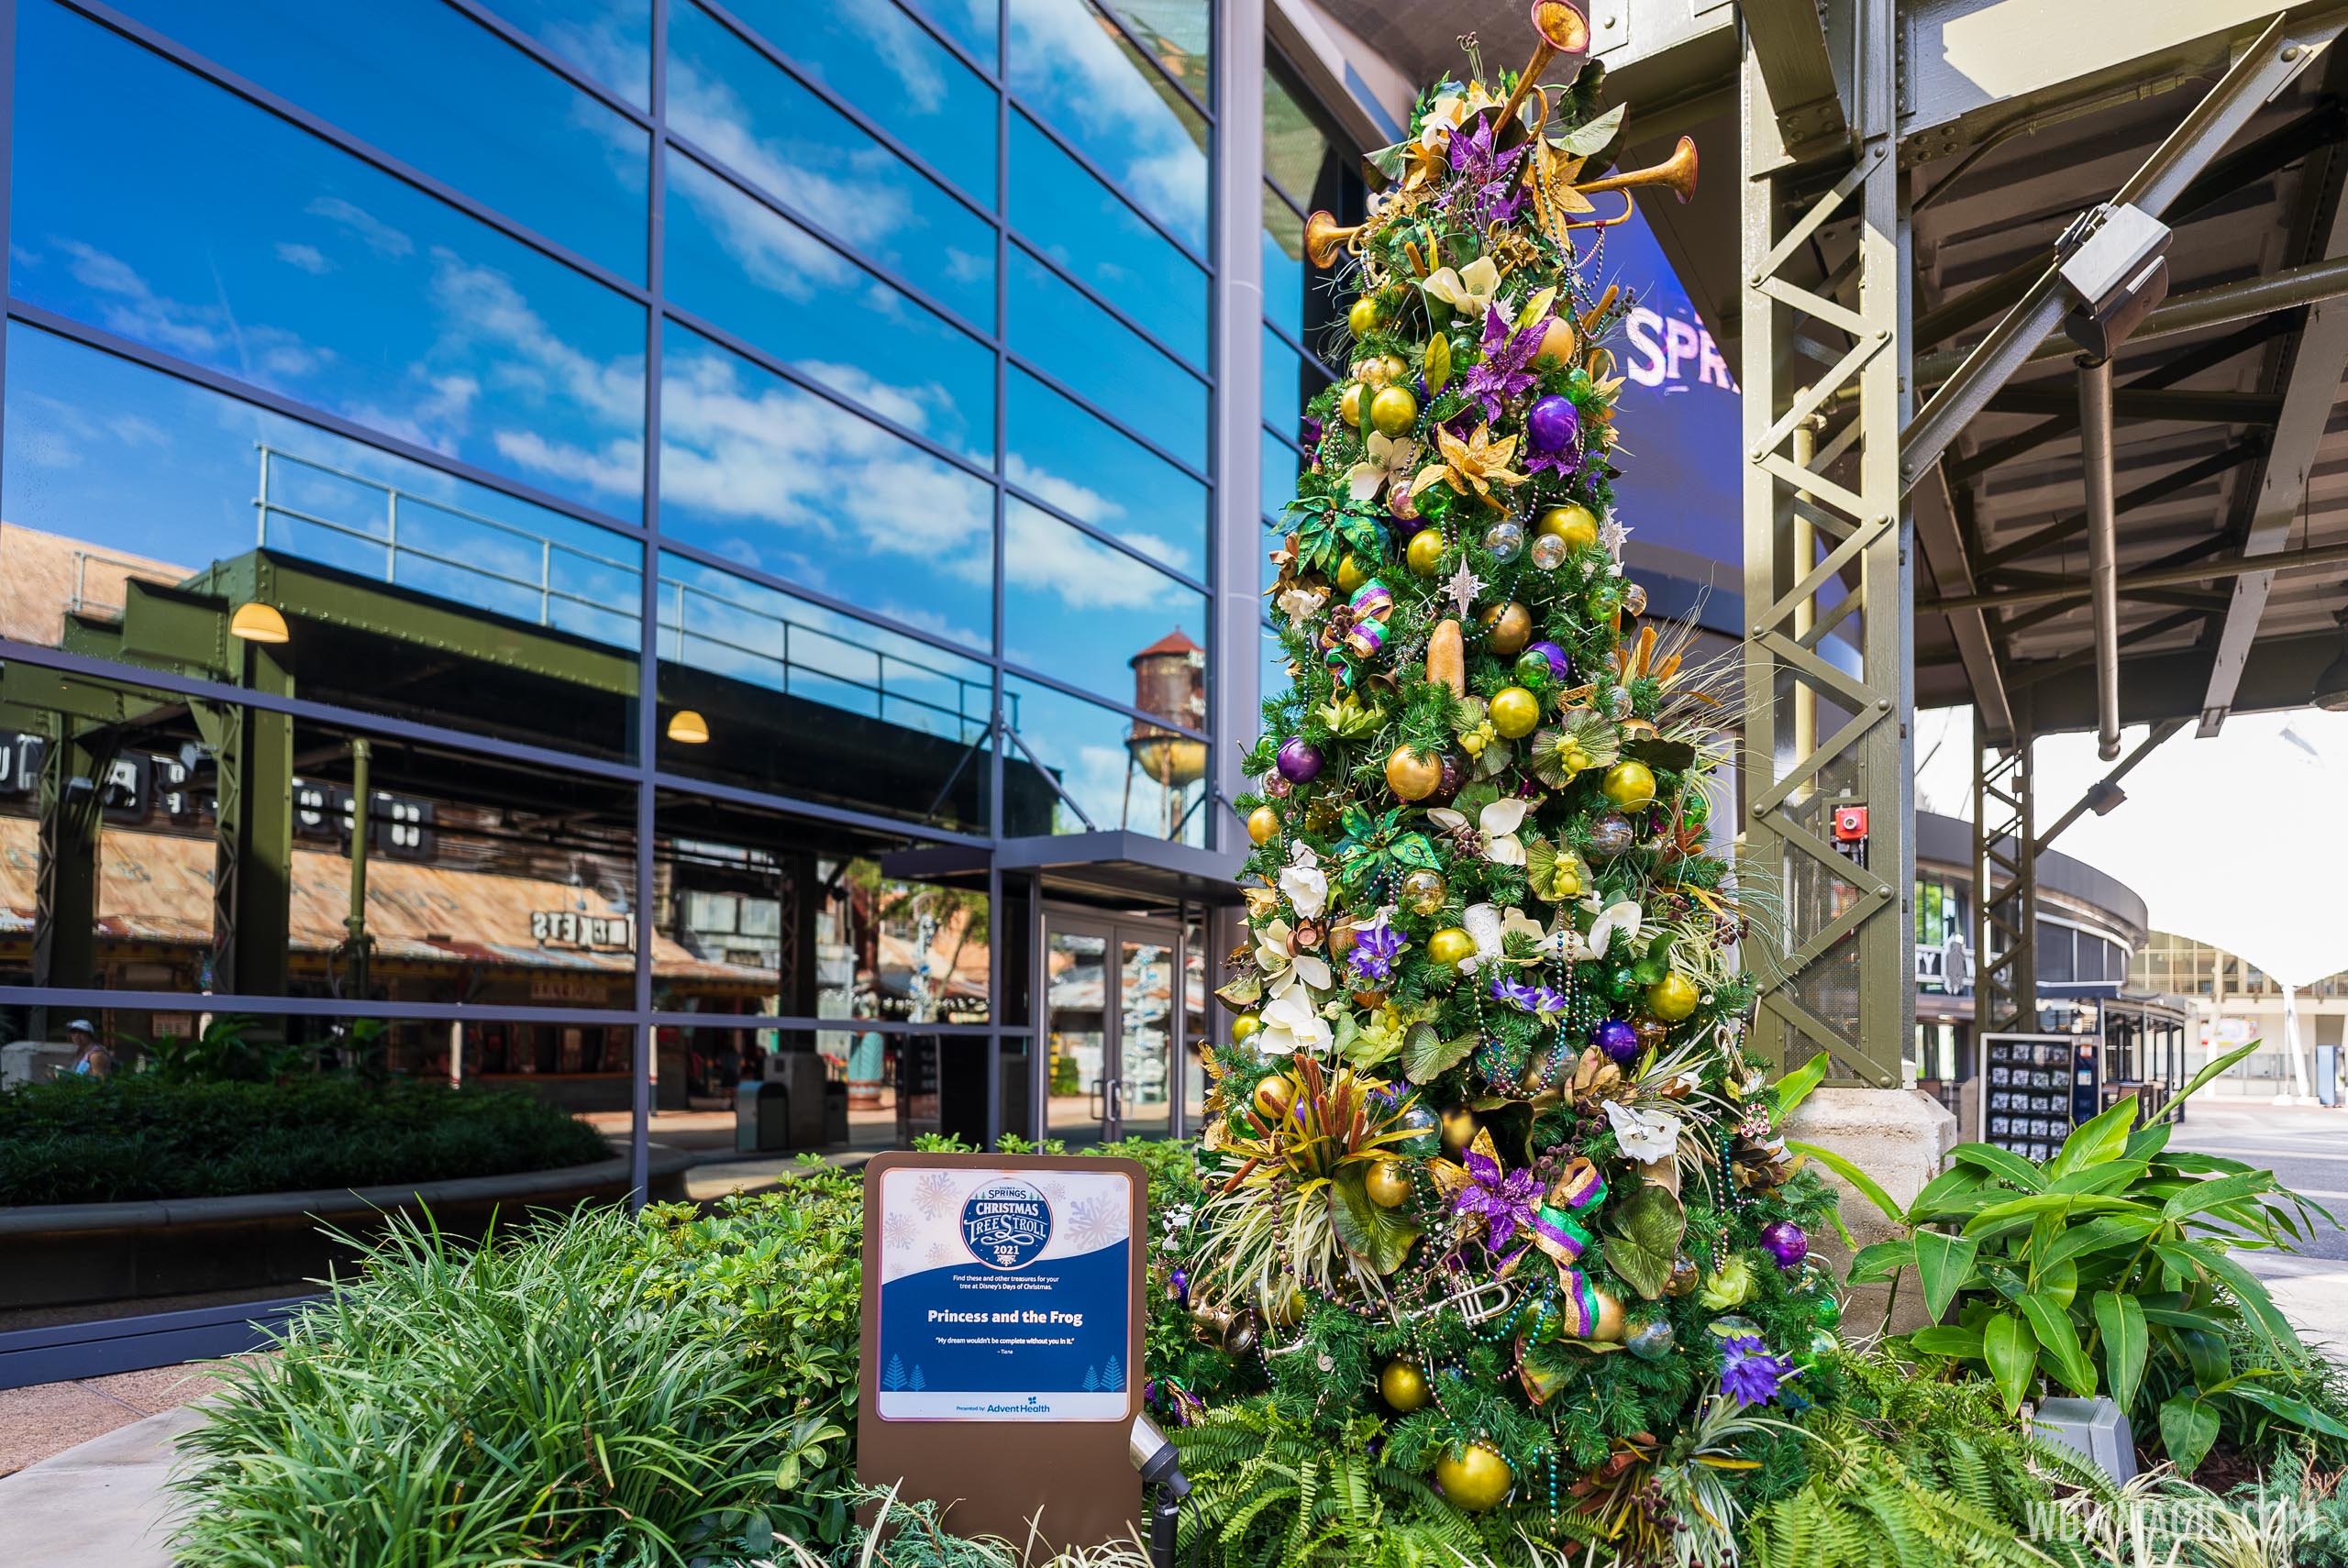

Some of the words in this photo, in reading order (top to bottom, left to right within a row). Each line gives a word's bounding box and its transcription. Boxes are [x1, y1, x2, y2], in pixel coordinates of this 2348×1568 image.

[1626, 306, 1741, 394] SPR
[988, 1189, 1026, 1199] SPRINGS
[975, 1202, 1039, 1217] CHRISTMAS
[963, 1216, 1000, 1245] TREE
[1000, 1214, 1047, 1239] STROLL
[993, 1245, 1020, 1255] 2021
[927, 1309, 989, 1323] Princess
[991, 1309, 1019, 1323] and
[1022, 1310, 1047, 1323] the
[1050, 1311, 1083, 1327] Frog
[987, 1404, 1050, 1412] AdventHealth
